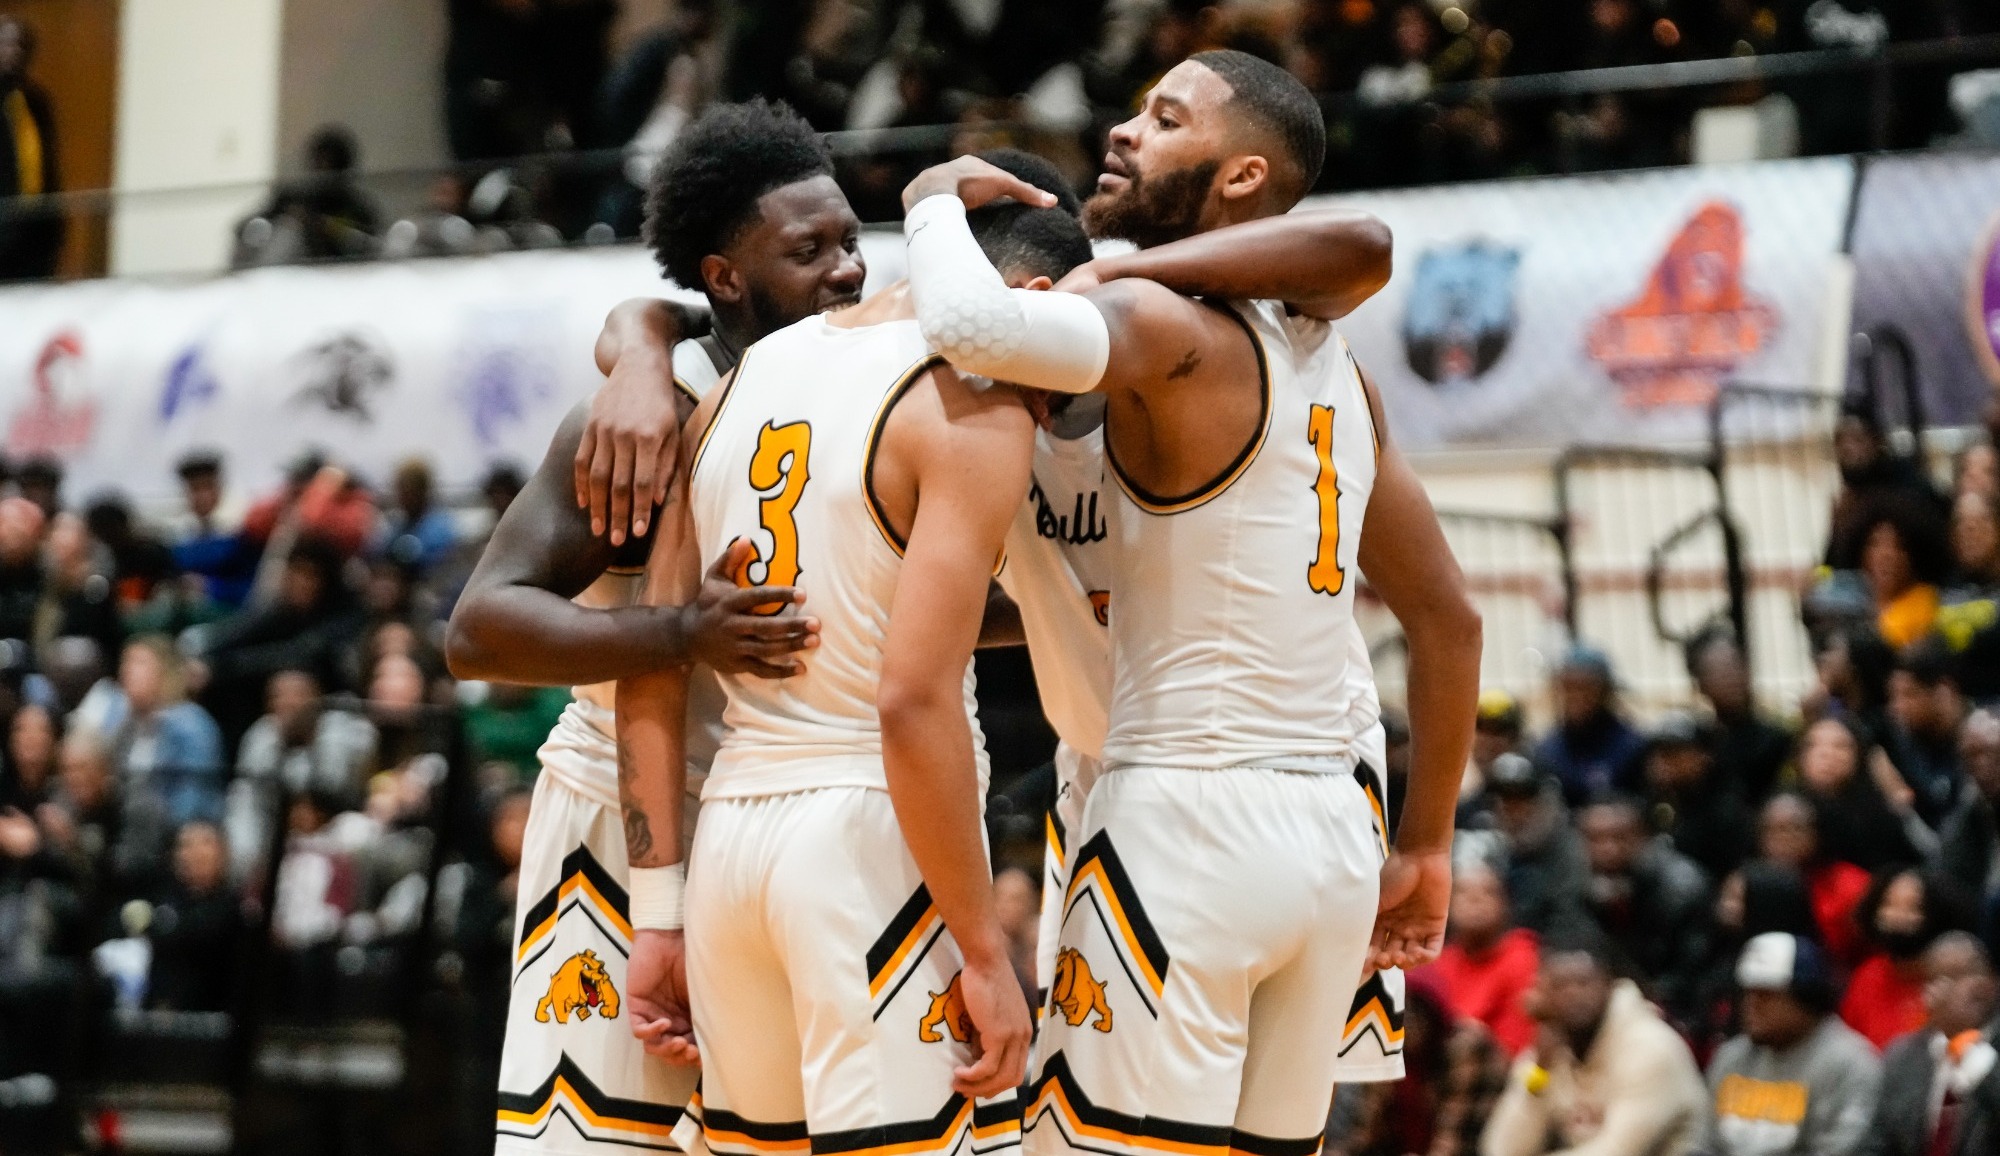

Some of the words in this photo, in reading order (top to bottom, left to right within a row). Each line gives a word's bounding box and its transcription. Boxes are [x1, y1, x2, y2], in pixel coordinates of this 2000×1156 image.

[726, 417, 811, 616] 3
[1029, 474, 1108, 545] Bull
[1307, 402, 1347, 597] 1
